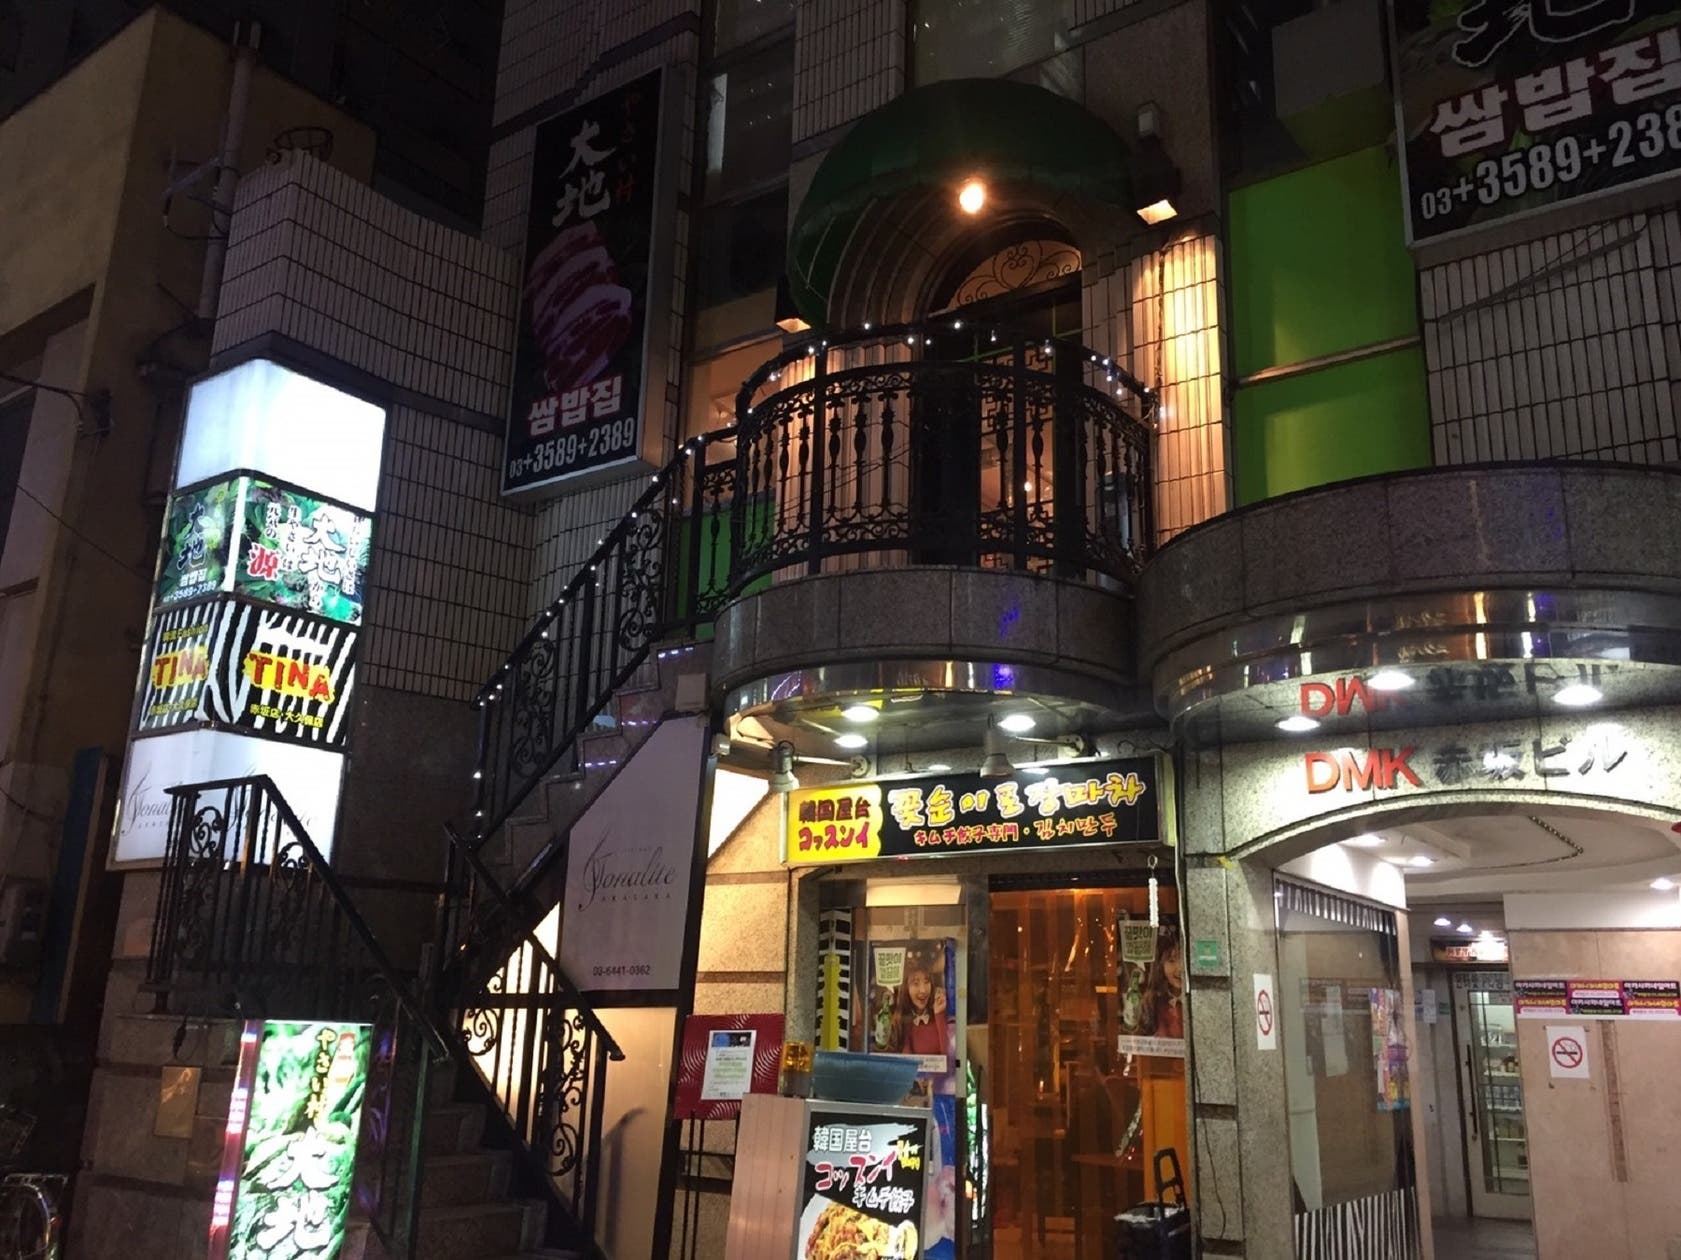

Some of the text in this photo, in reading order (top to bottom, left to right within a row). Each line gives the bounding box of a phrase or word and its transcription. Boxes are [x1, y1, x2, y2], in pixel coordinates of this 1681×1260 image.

[1429, 27, 1681, 158] 쌈밥집
[552, 119, 617, 228] 大地
[528, 375, 623, 437] 쌈밥집
[509, 417, 635, 479] 03+3589+2389
[155, 651, 207, 686] TINA
[250, 653, 331, 701] TINA
[1304, 746, 1424, 794] DMK
[799, 822, 870, 851] コッスンイ
[813, 1126, 873, 1152] 韓国屋台
[256, 1126, 341, 1250] 大地
